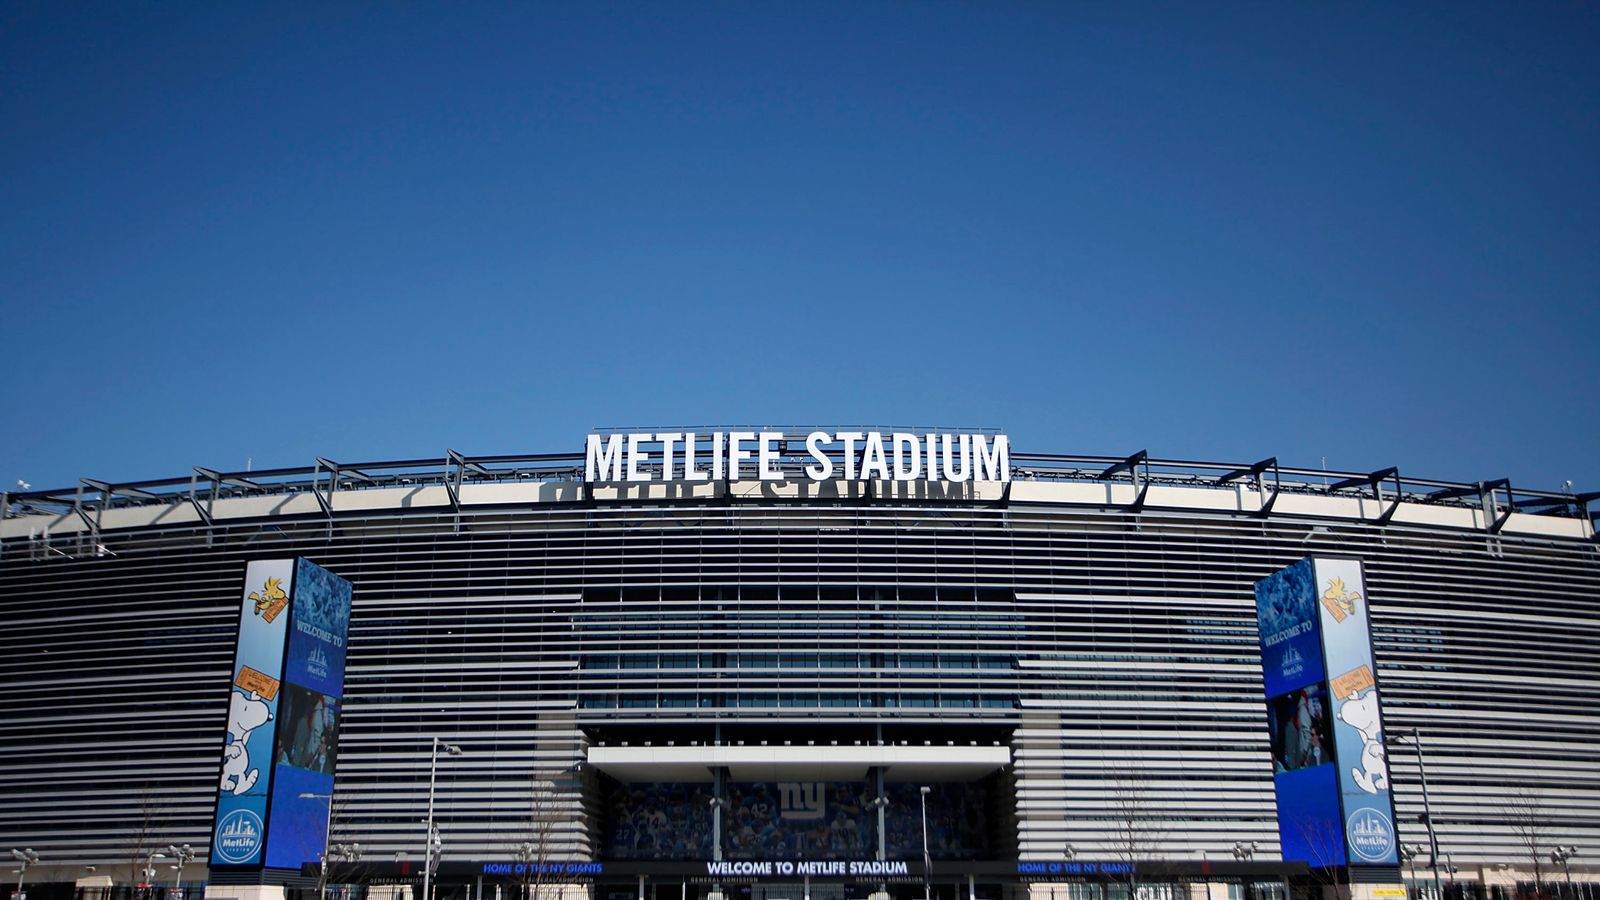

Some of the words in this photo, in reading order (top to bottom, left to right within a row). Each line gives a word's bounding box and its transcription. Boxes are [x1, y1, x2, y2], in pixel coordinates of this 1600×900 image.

[585, 431, 785, 482] METLIFE
[804, 431, 1010, 483] STADIUM
[297, 620, 332, 643] WELCOME
[333, 633, 343, 647] TO
[1264, 624, 1301, 647] WELCOME
[1301, 620, 1313, 633] TO
[223, 838, 255, 847] MetLife
[1356, 836, 1388, 846] MetLife
[484, 864, 512, 873] HOME
[550, 864, 564, 873] NY
[566, 864, 602, 873] GIANTS
[707, 861, 772, 875] WELCOME
[775, 861, 794, 875] TO
[797, 861, 846, 875] METLIFE
[850, 861, 908, 875] STADIUM
[1017, 863, 1046, 873] HOME
[1049, 863, 1062, 873] OF
[1065, 863, 1080, 873] THE
[1083, 863, 1098, 873] NY
